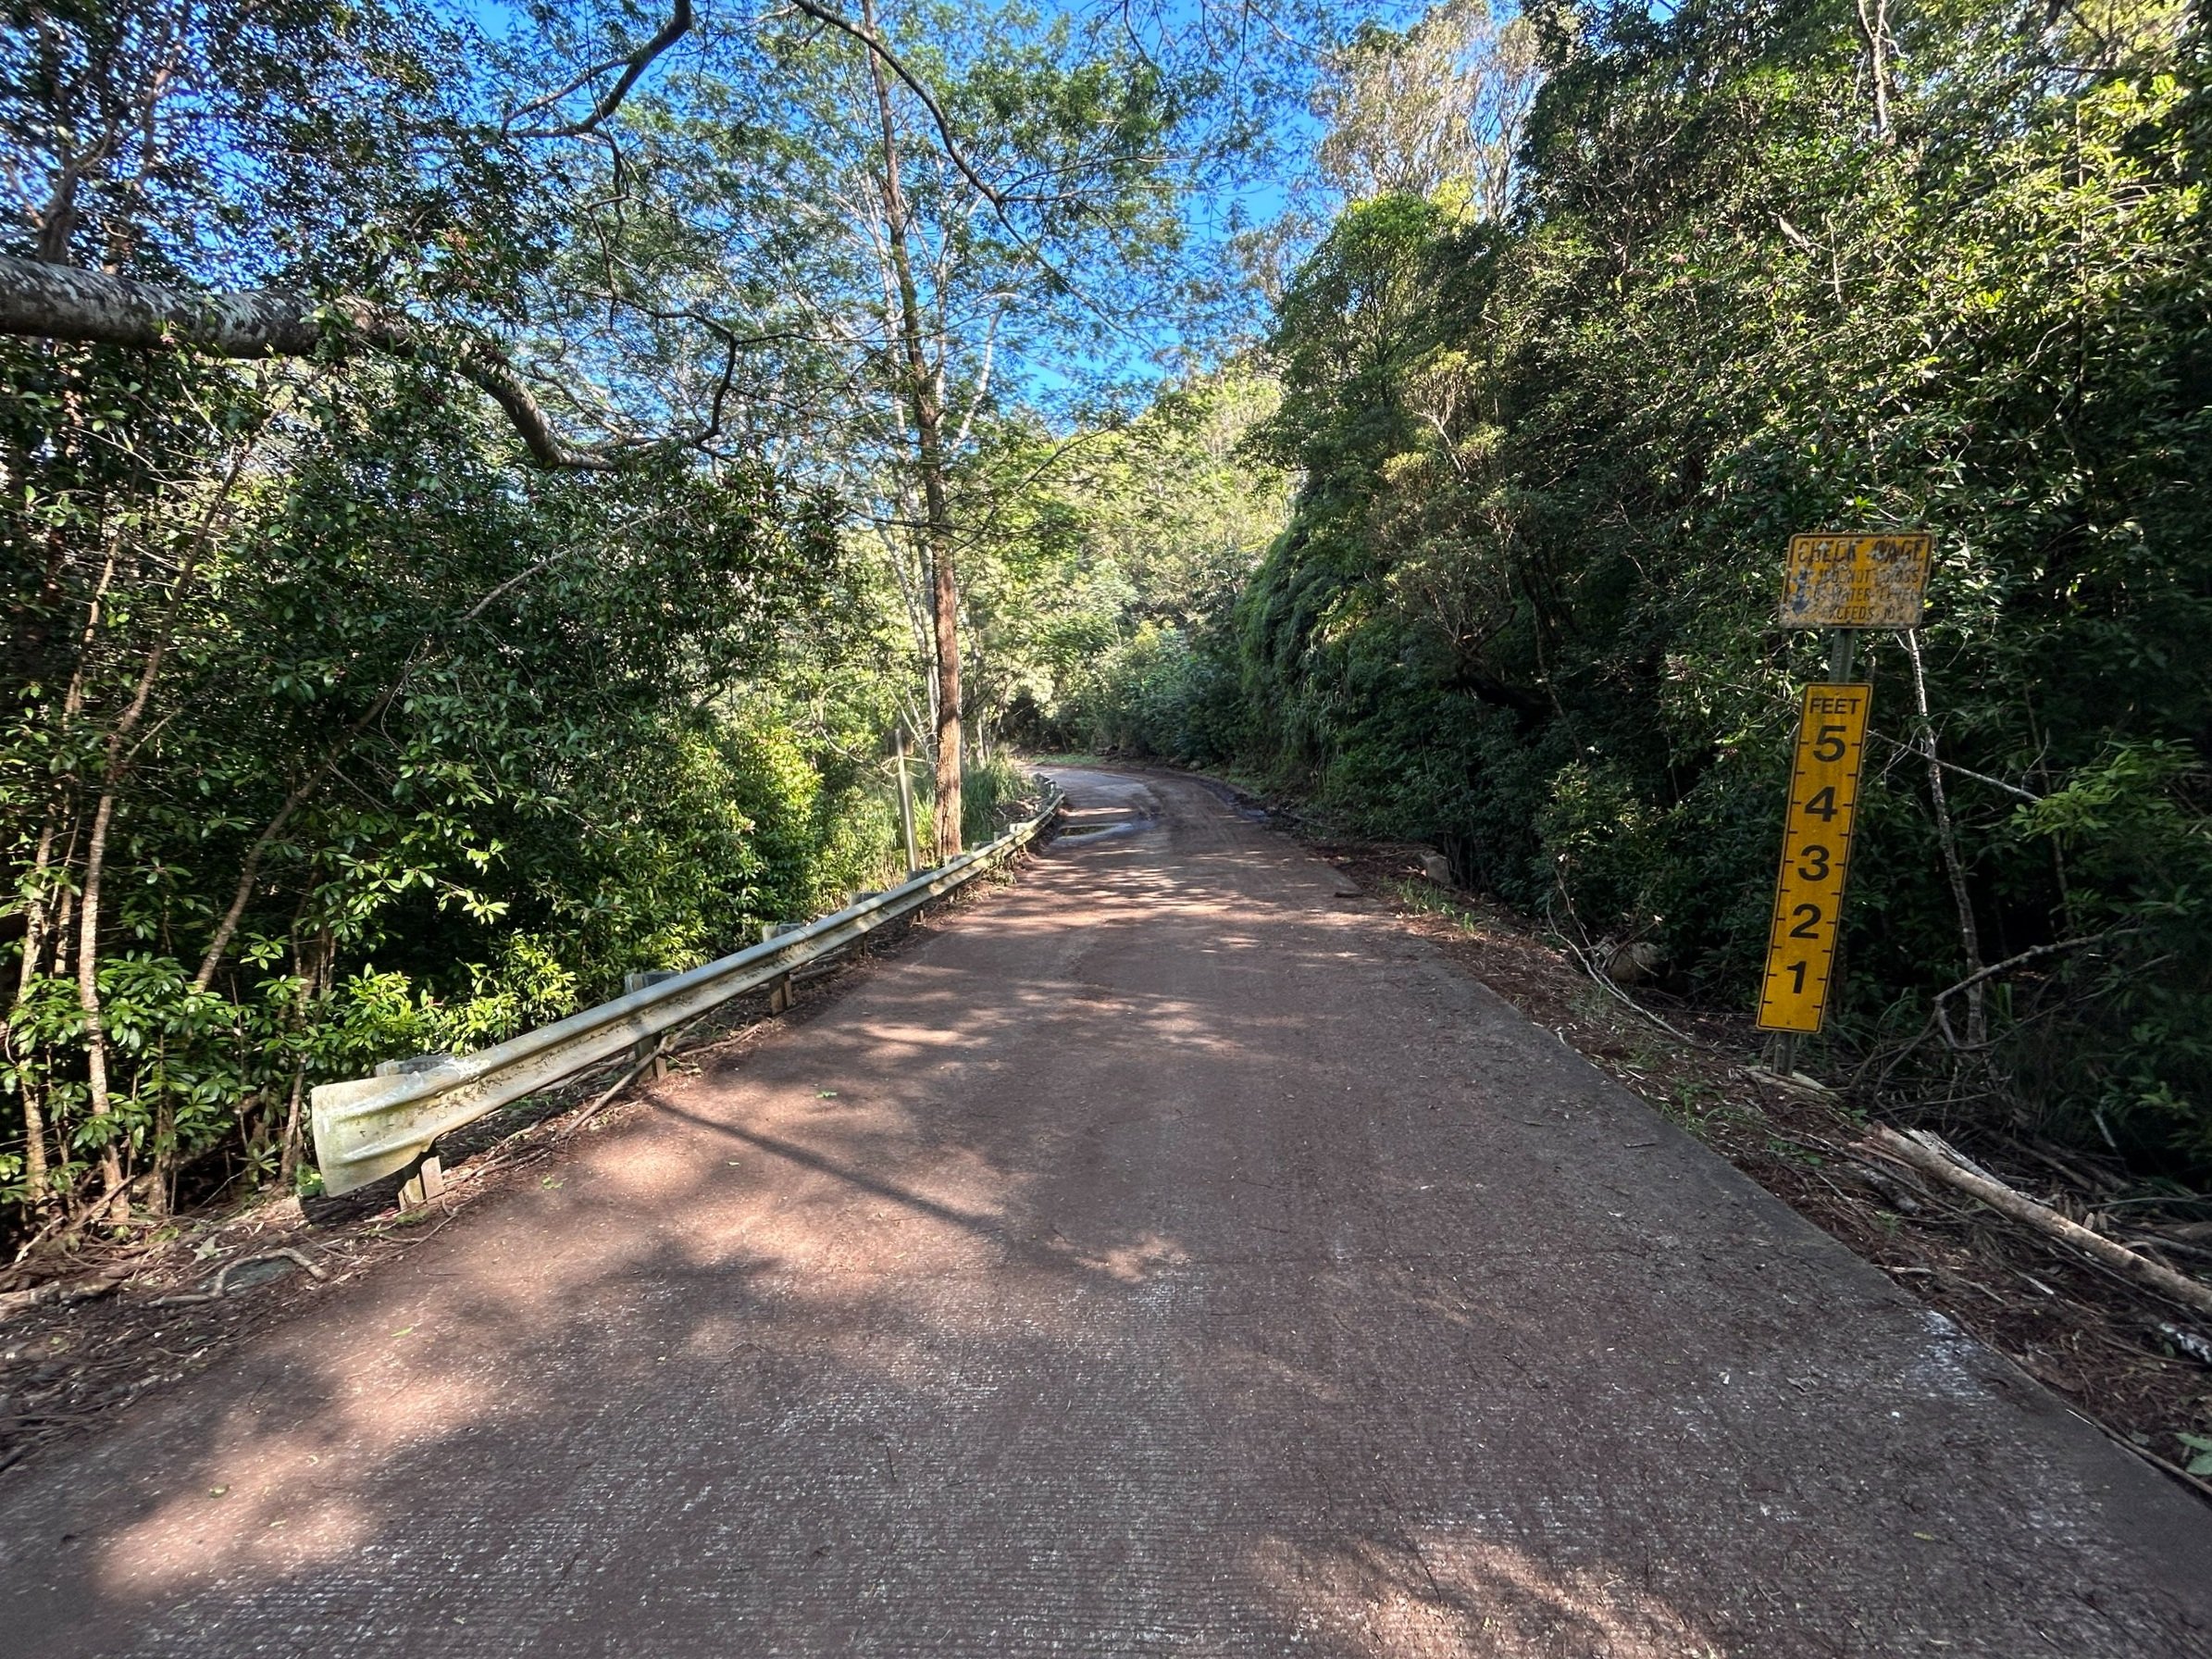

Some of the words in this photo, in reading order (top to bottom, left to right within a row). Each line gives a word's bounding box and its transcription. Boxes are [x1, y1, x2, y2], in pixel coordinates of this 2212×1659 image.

[1797, 540, 1863, 564] CHECK
[1847, 568, 1875, 584] NOT
[1809, 697, 1861, 715] FEET
[1813, 725, 1845, 762] 5
[1804, 786, 1838, 822] 4
[1797, 844, 1830, 881] 3
[1789, 904, 1821, 940] 2
[1786, 961, 1807, 994] 1
